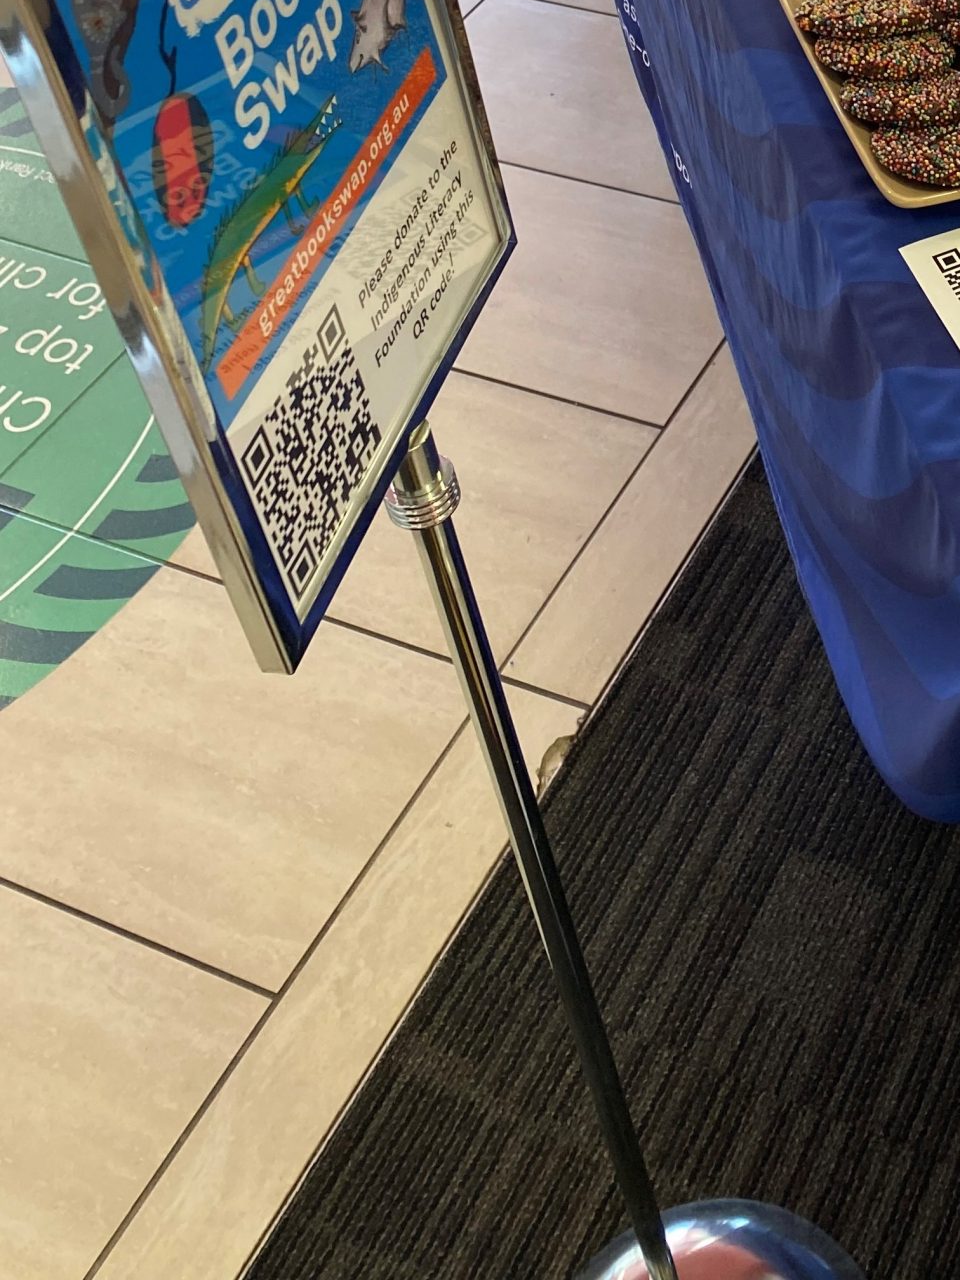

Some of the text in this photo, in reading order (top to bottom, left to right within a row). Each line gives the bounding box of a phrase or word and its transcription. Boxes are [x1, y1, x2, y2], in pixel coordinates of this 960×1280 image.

[257, 93, 411, 338] greatbookswap.org.au
[358, 141, 458, 309] Please donate to the
[371, 170, 463, 331] Indigenous Literacy
[374, 189, 475, 368] Foundation using this
[412, 252, 455, 340] QR code!
[15, 325, 94, 375] top
[45, 278, 107, 320] for
